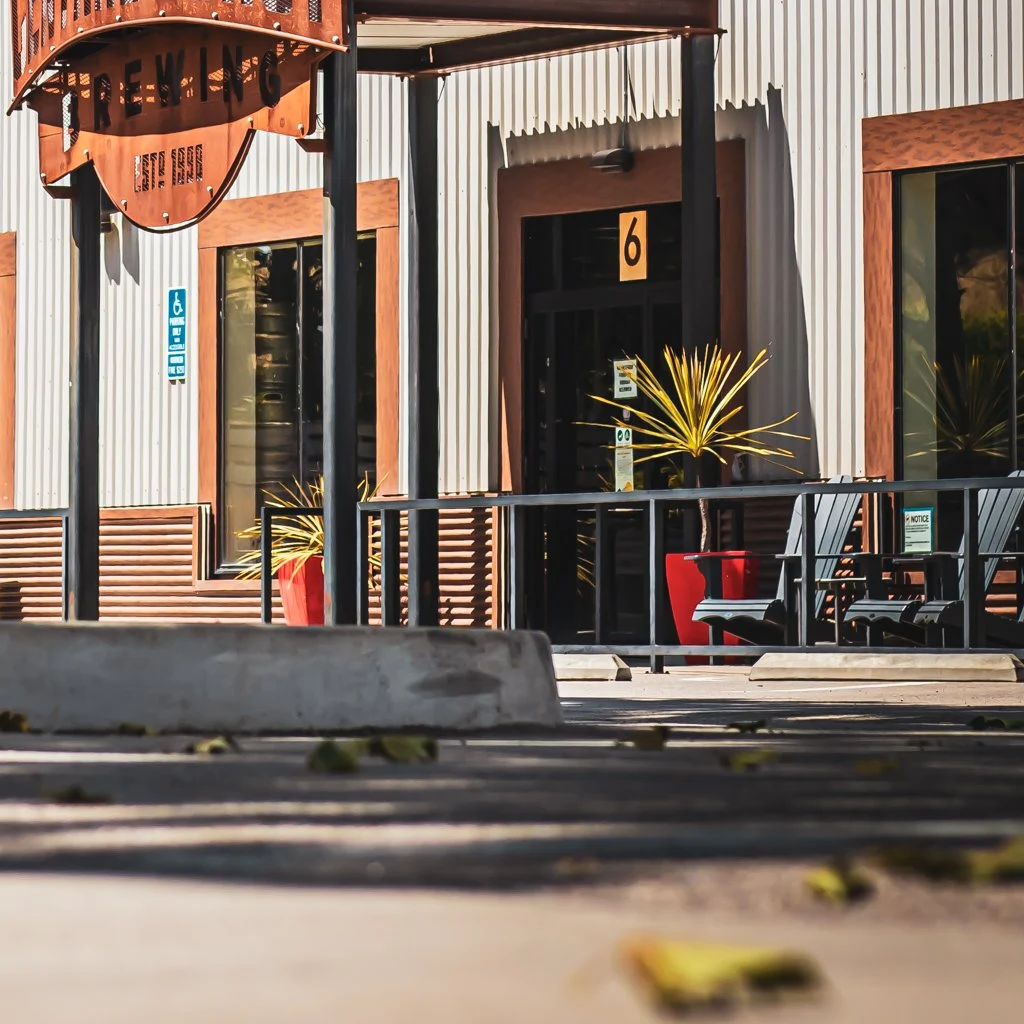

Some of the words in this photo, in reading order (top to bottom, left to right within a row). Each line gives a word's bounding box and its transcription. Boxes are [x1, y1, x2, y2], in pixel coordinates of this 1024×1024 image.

[62, 43, 282, 154] BREWING
[624, 216, 642, 267] 6
[910, 514, 930, 522] NOTICE
